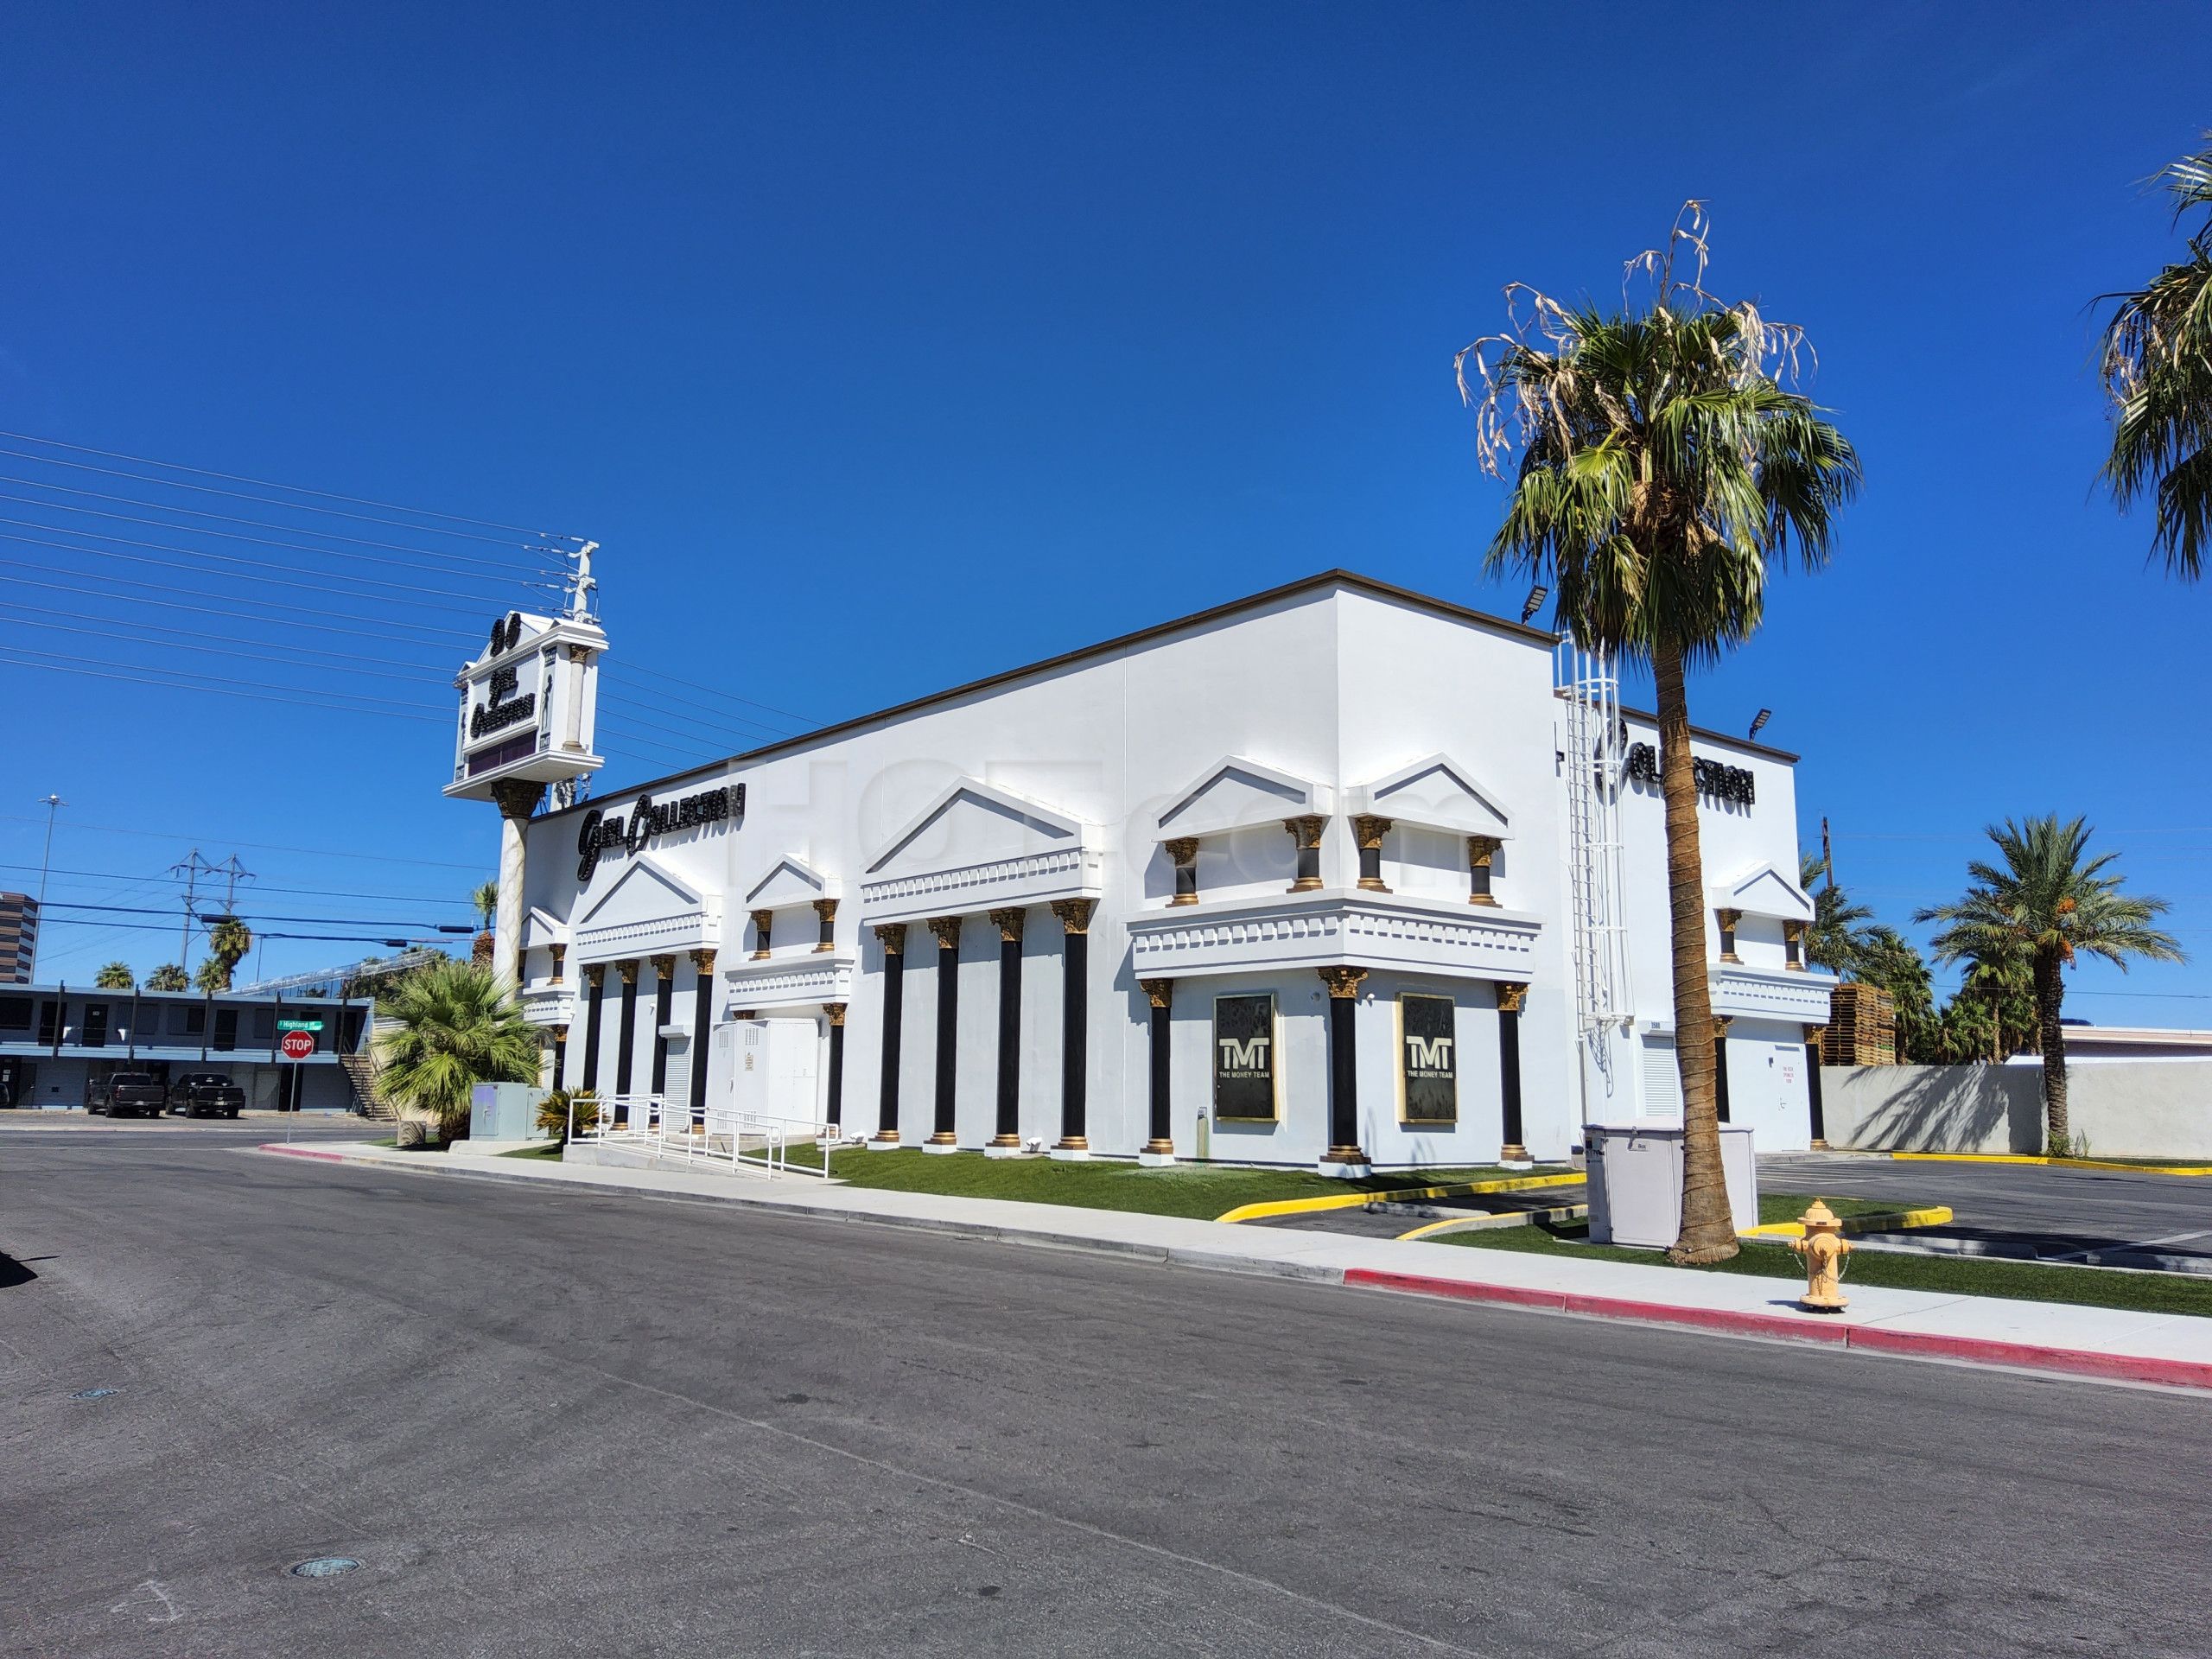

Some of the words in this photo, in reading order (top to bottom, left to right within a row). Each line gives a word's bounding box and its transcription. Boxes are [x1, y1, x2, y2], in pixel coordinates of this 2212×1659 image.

[1593, 717, 1755, 805] COLCTION
[283, 1020, 308, 1030] Highland
[283, 1039, 312, 1051] STOP
[1219, 1038, 1269, 1069] TMT
[1406, 1036, 1452, 1070] TMT
